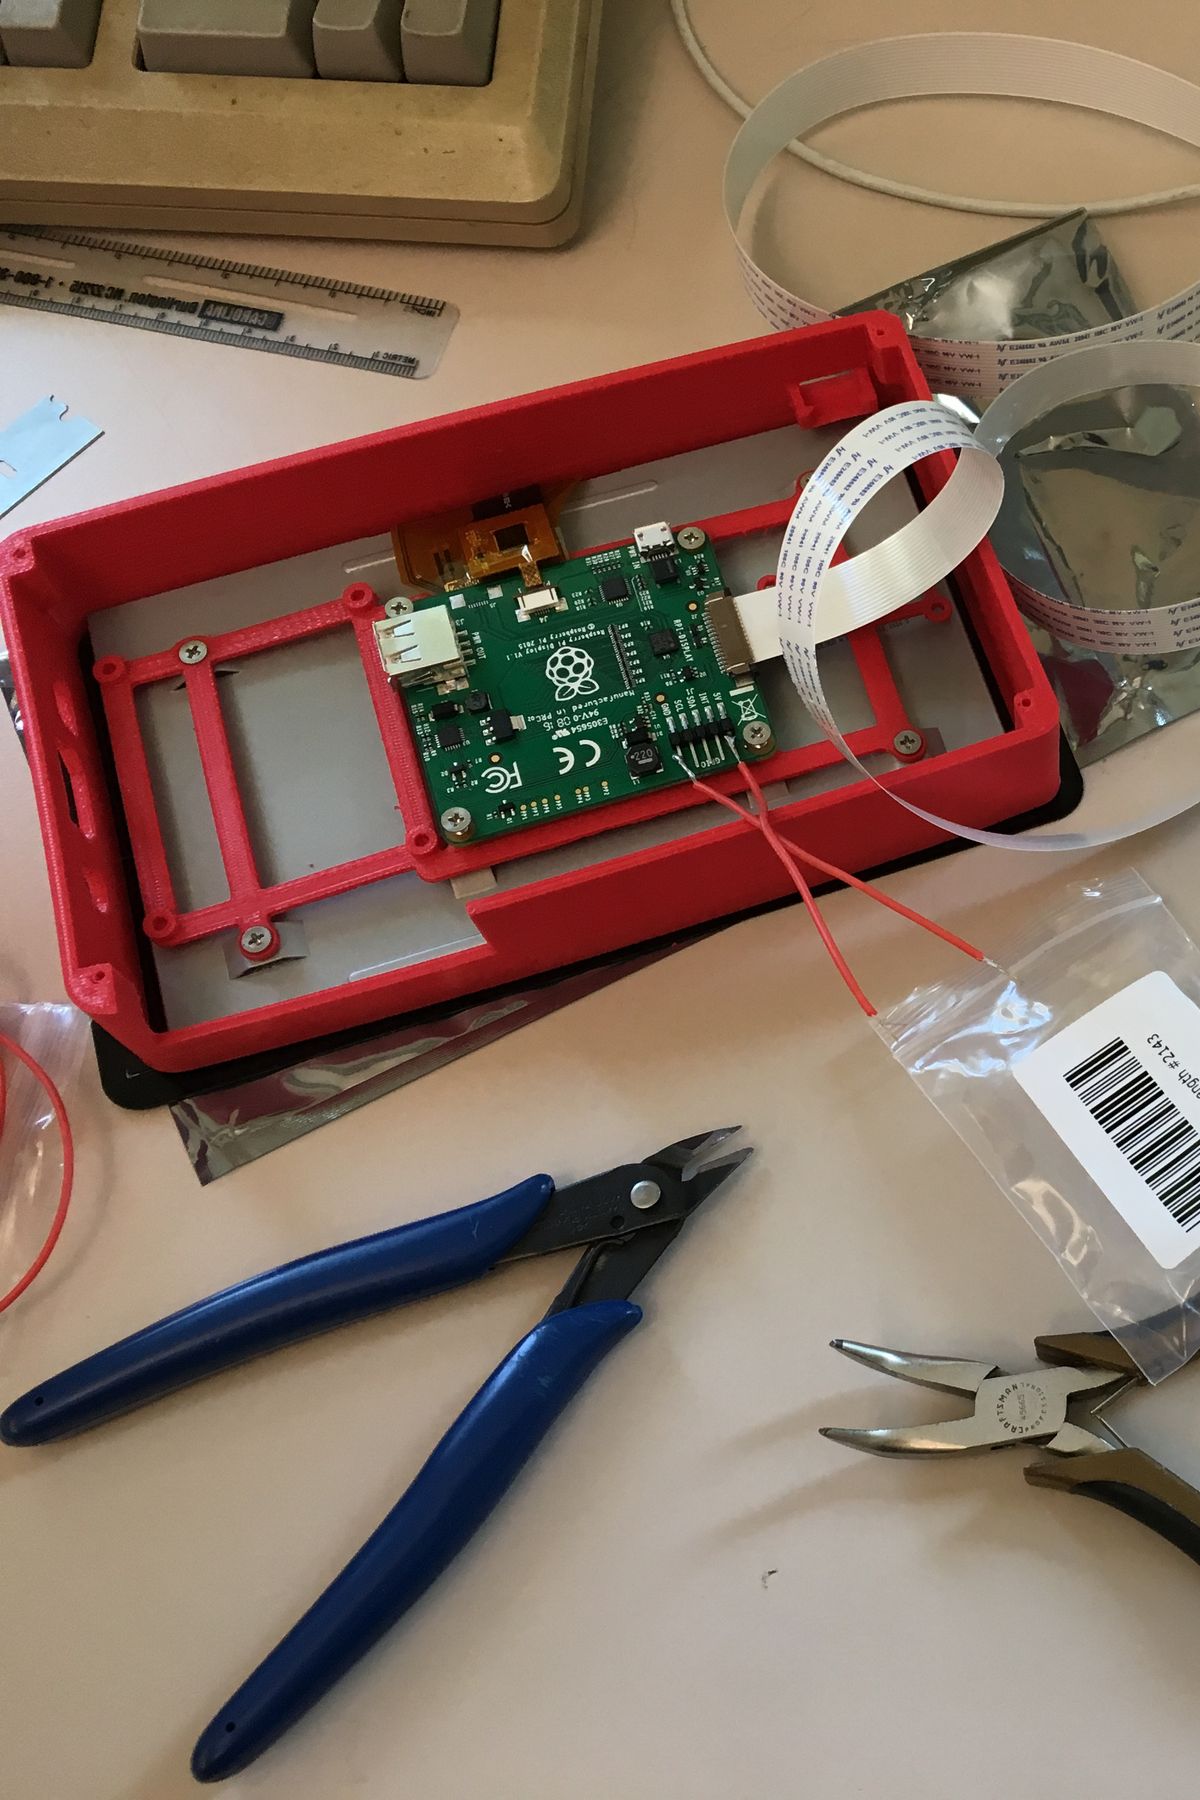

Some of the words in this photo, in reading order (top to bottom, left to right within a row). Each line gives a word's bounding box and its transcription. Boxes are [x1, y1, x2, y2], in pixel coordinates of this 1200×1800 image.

[627, 545, 638, 558] PWR
[632, 561, 641, 570] IN
[472, 631, 482, 645] PWR
[539, 637, 548, 645] Pi
[558, 640, 567, 648] Pi
[673, 619, 694, 662] RPI-DISPLAY
[518, 640, 536, 650] 2015
[525, 643, 555, 655] Display
[475, 646, 487, 660] OUT
[571, 690, 635, 712] Manufactured
[686, 696, 697, 709] SDA
[698, 692, 710, 704] INT
[712, 692, 722, 701] 5V
[661, 702, 672, 716] GND
[673, 699, 684, 712] SCL
[572, 708, 600, 722] 94V-0
[570, 717, 609, 734] E305654
[634, 749, 653, 760] 220
[1147, 1033, 1180, 1070] #2143
[997, 1383, 1023, 1434] CRAFTSMAN
